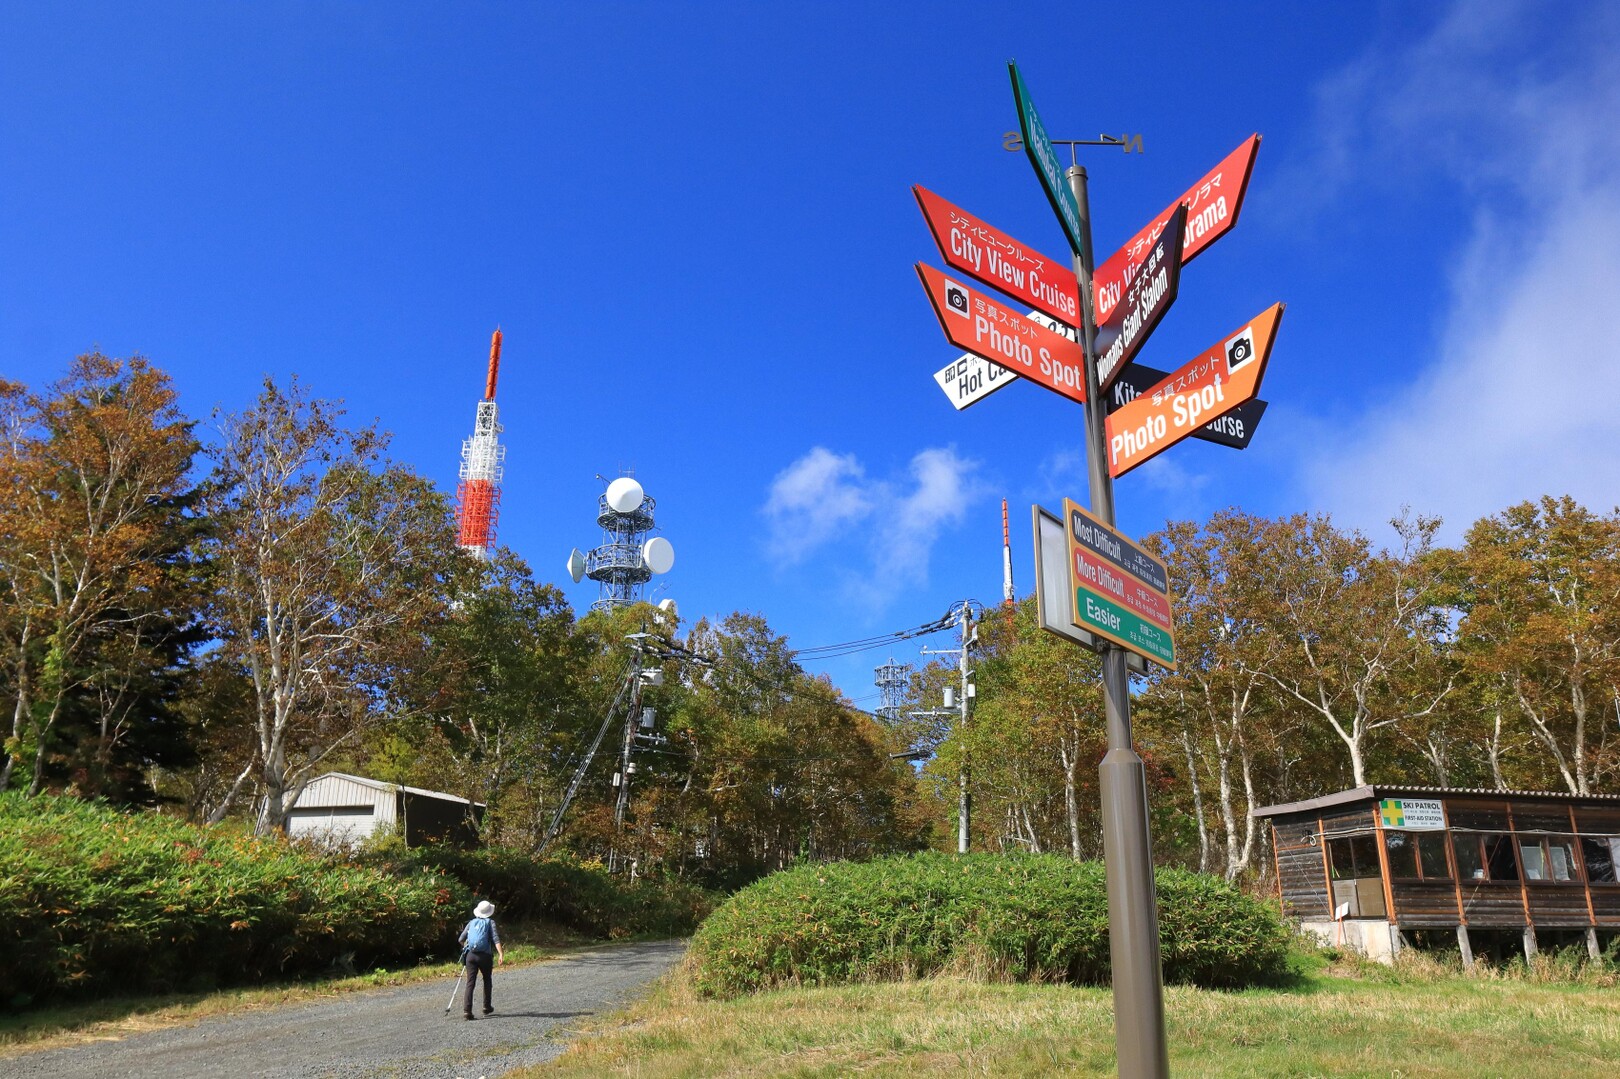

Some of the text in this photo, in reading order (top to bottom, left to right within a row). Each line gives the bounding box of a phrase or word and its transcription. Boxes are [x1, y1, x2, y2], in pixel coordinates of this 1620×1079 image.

[1057, 177, 1081, 243] Course
[950, 211, 1045, 273] シティビュークルーズ
[950, 227, 1076, 317] City View Cruise
[1099, 279, 1121, 314] City
[1183, 195, 1227, 249] orama
[1128, 242, 1165, 307] 女子大回転
[975, 298, 1039, 338] 写真スポット
[1122, 305, 1143, 348] Giant
[1141, 266, 1169, 321] Slalom
[975, 313, 1082, 391] Photo Spot
[1152, 355, 1220, 407] 写真スポット
[958, 367, 983, 400] Hot
[1114, 380, 1245, 439] Kit urse
[1111, 372, 1225, 466] Photo Spot
[1073, 514, 1122, 562] Most Difficult
[1076, 553, 1097, 583] More
[1097, 565, 1125, 597] Difficult
[1086, 597, 1121, 631] Easier
[1415, 802, 1440, 810] PATROL
